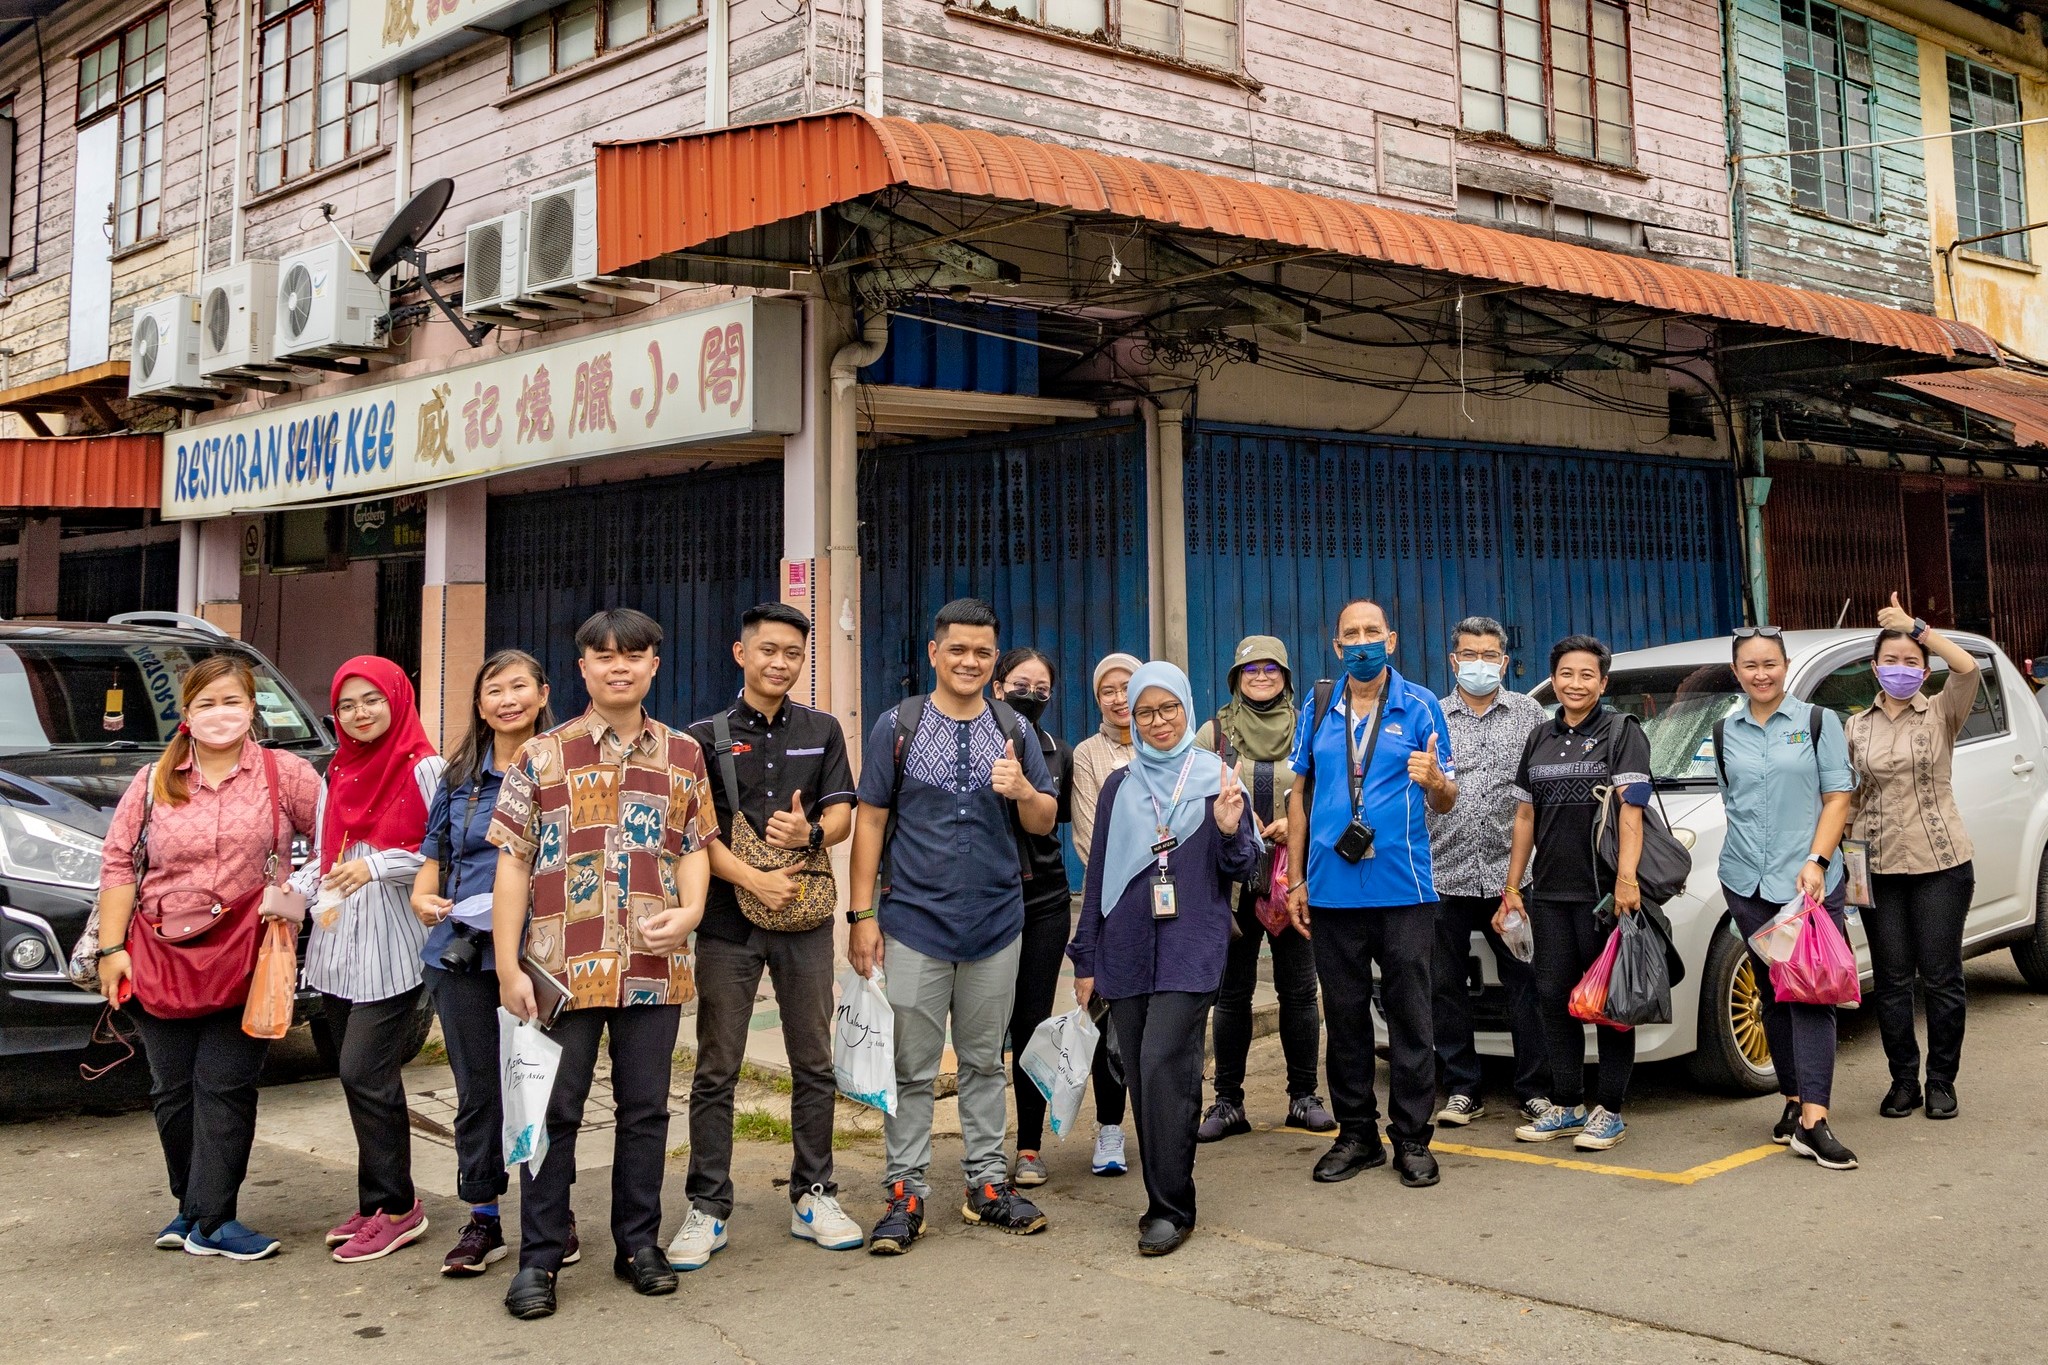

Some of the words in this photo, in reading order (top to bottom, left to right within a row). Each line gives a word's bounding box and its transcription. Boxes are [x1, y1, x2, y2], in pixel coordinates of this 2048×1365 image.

[174, 424, 282, 502] RESTORAN
[286, 410, 339, 491] SENG
[344, 400, 395, 476] KEE
[354, 503, 386, 528] Carlsberg
[526, 1072, 545, 1080] Asia
